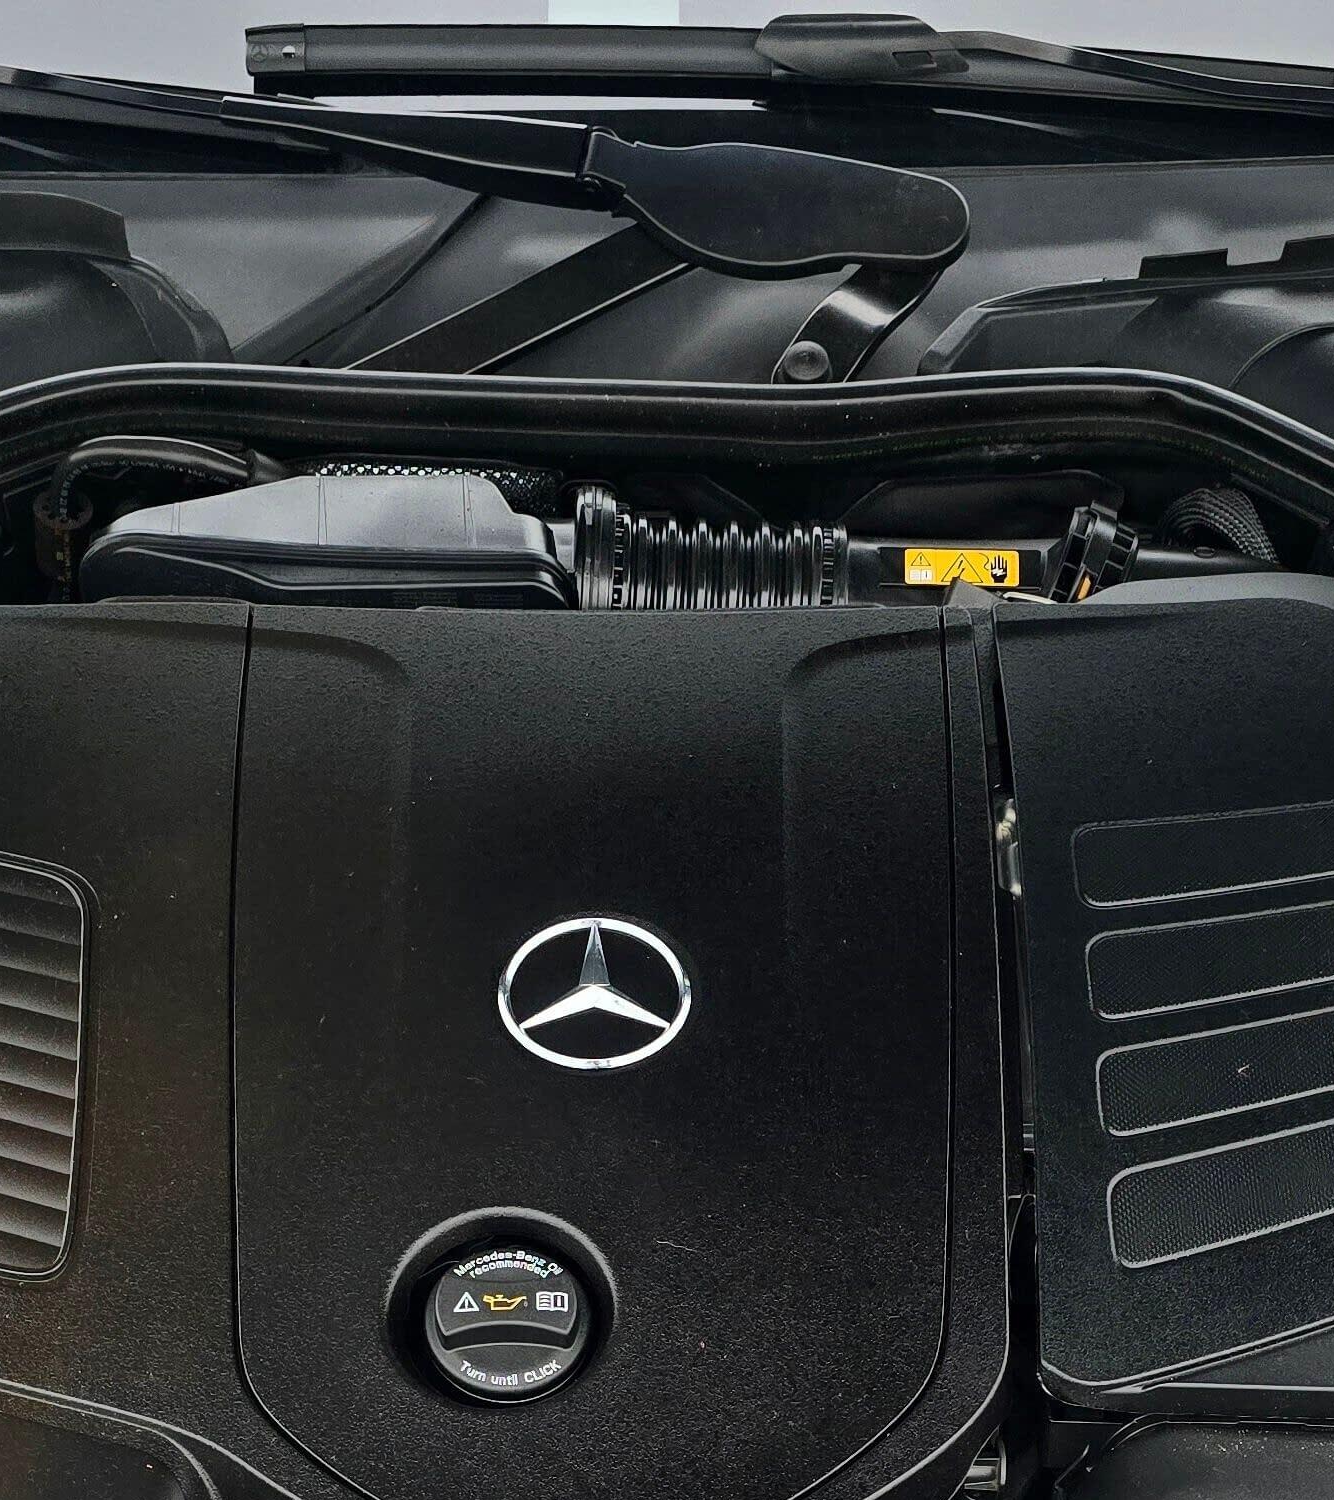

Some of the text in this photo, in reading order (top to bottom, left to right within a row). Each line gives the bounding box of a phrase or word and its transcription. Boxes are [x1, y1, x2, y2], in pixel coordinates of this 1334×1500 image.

[453, 1251, 564, 1277] Mercedes-Benz Oil
[469, 1260, 551, 1278] recommended
[460, 1359, 562, 1386] Turn until CLICK
